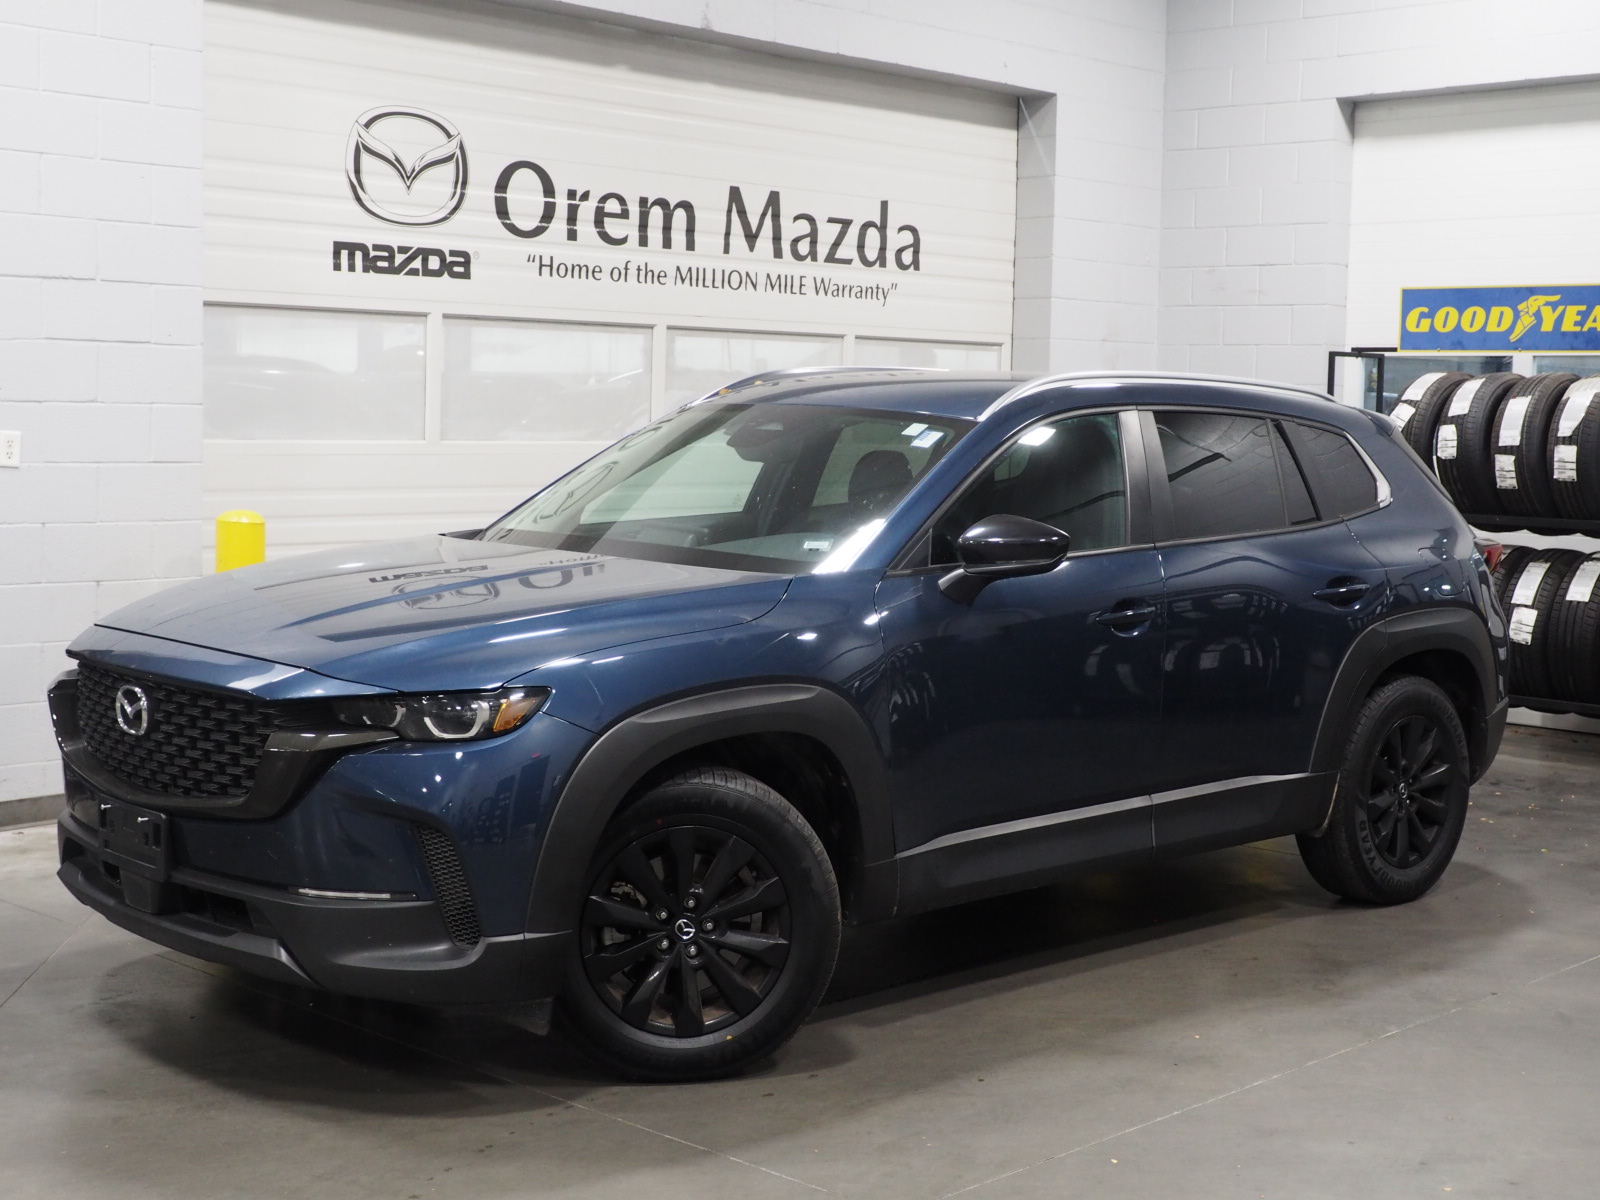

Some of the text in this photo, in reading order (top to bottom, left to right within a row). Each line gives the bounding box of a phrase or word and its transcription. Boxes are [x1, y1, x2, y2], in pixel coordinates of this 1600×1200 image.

[494, 160, 921, 272] Orem Mazda
[332, 240, 472, 280] mazda
[609, 260, 632, 283] of
[636, 262, 668, 286] the
[674, 265, 758, 292] MILLION
[764, 272, 808, 296] MILE
